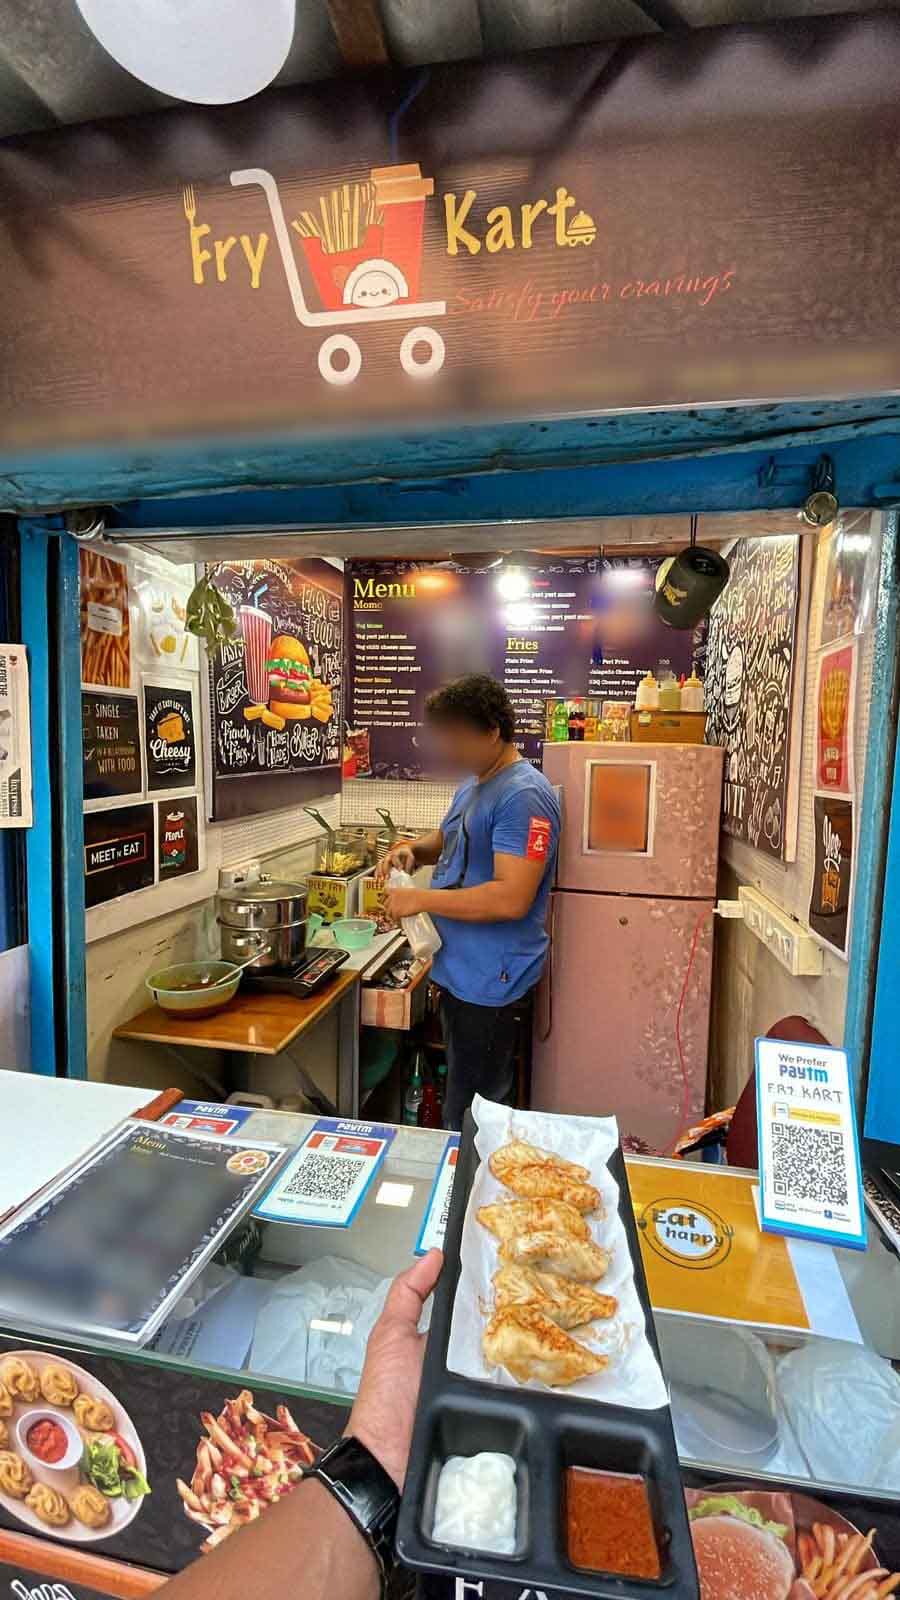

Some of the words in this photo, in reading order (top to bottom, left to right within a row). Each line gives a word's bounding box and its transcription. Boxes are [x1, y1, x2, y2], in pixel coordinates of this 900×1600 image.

[188, 222, 270, 289] Fry
[443, 187, 576, 256] Kart
[551, 284, 610, 320] your
[620, 271, 736, 306] cravings
[352, 578, 417, 599] Menu
[506, 637, 539, 650] Fries
[95, 703, 120, 719] SINGLE
[96, 726, 119, 740] TAKEN
[149, 738, 191, 767] Cheesy
[90, 848, 117, 865] MEET
[123, 842, 141, 856] EAT
[778, 1053, 795, 1064] We
[796, 1056, 828, 1067] Prefer
[802, 1086, 843, 1104] KART
[652, 1207, 698, 1228] Eat
[665, 1226, 724, 1248] happy
